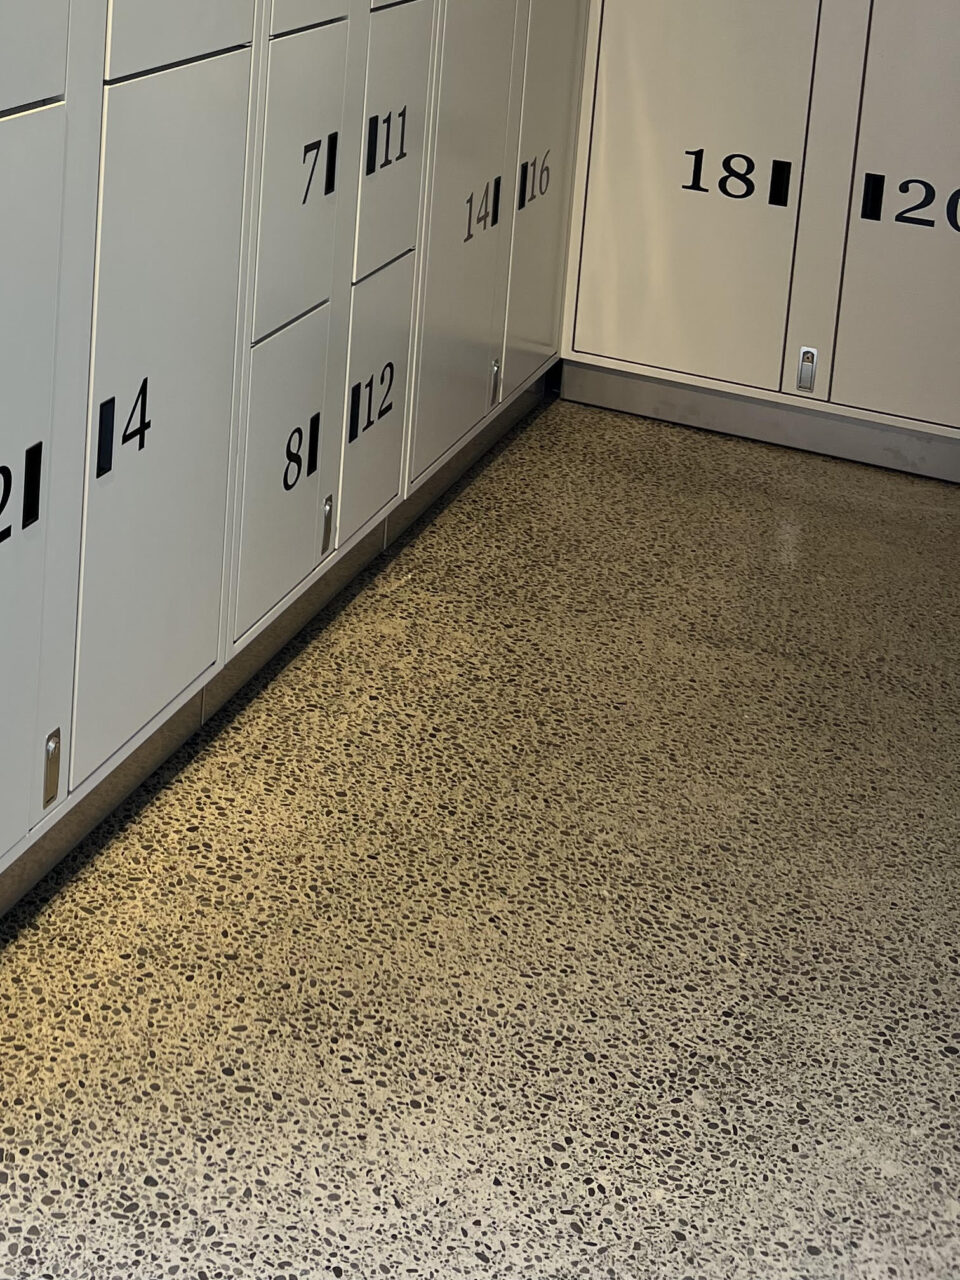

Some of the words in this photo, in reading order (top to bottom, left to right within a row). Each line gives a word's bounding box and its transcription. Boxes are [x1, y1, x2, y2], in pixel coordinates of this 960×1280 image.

[379, 105, 407, 169] 11
[302, 139, 322, 205] 7
[528, 148, 550, 203] 16
[681, 148, 756, 199] 18
[464, 181, 490, 243] 14
[121, 376, 151, 451] 4
[362, 362, 394, 432] 12
[282, 427, 303, 491] 8
